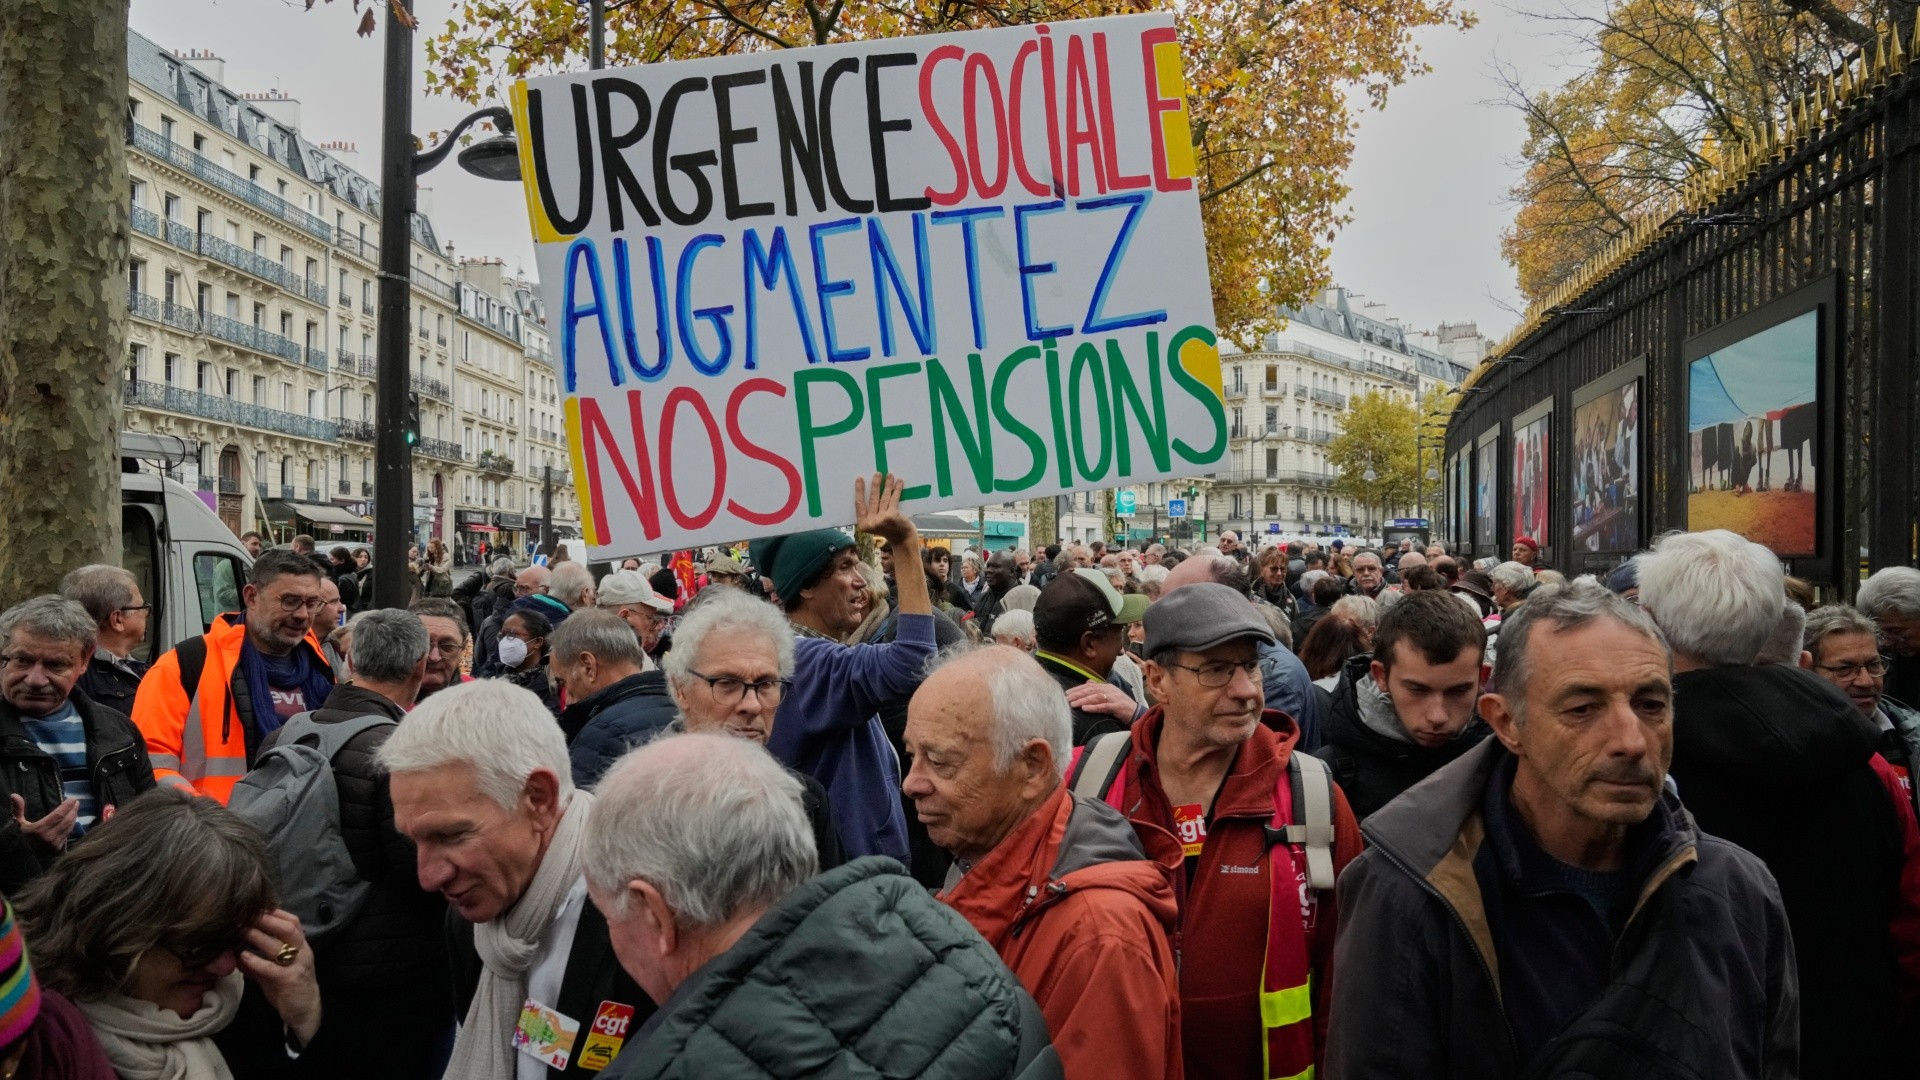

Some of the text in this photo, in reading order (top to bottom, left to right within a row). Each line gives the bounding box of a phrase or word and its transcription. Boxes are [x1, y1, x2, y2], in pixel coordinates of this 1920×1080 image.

[528, 52, 931, 235] URGENCE
[562, 190, 1168, 393] AUGMENTEZ
[580, 378, 802, 545] NOS
[1230, 865, 1259, 874] simond
[595, 1015, 630, 1036] cgt
